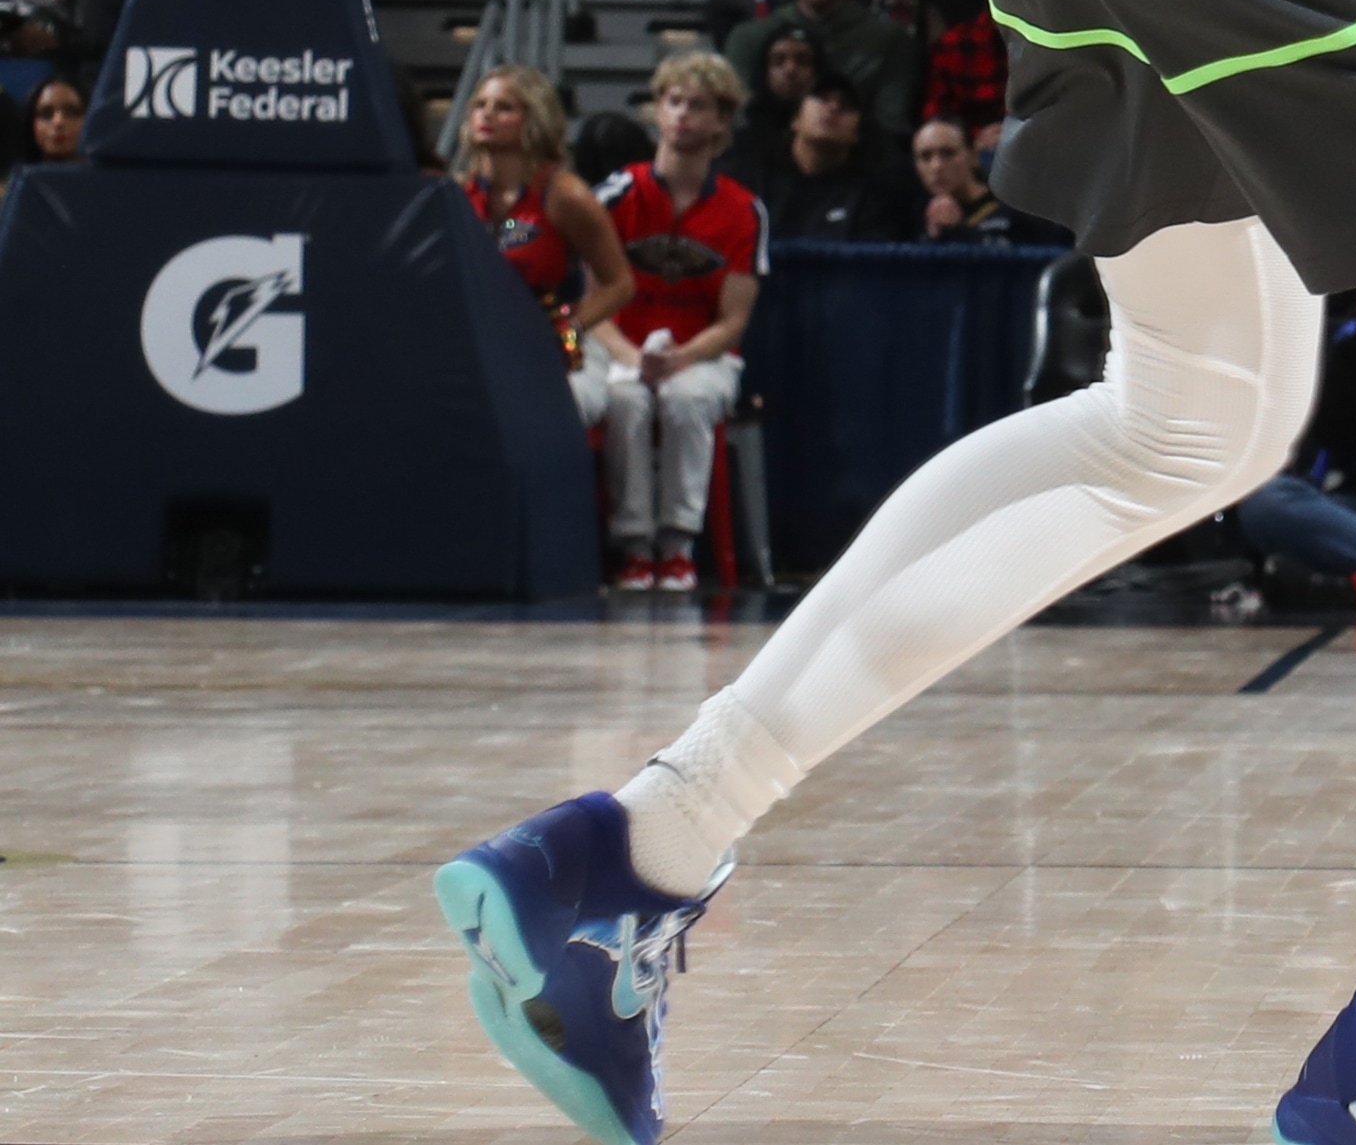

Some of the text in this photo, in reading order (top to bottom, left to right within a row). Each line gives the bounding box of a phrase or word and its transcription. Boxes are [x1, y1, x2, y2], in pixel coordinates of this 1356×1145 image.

[209, 49, 353, 84] Keesler
[208, 86, 349, 121] Federal
[140, 233, 306, 416] G
